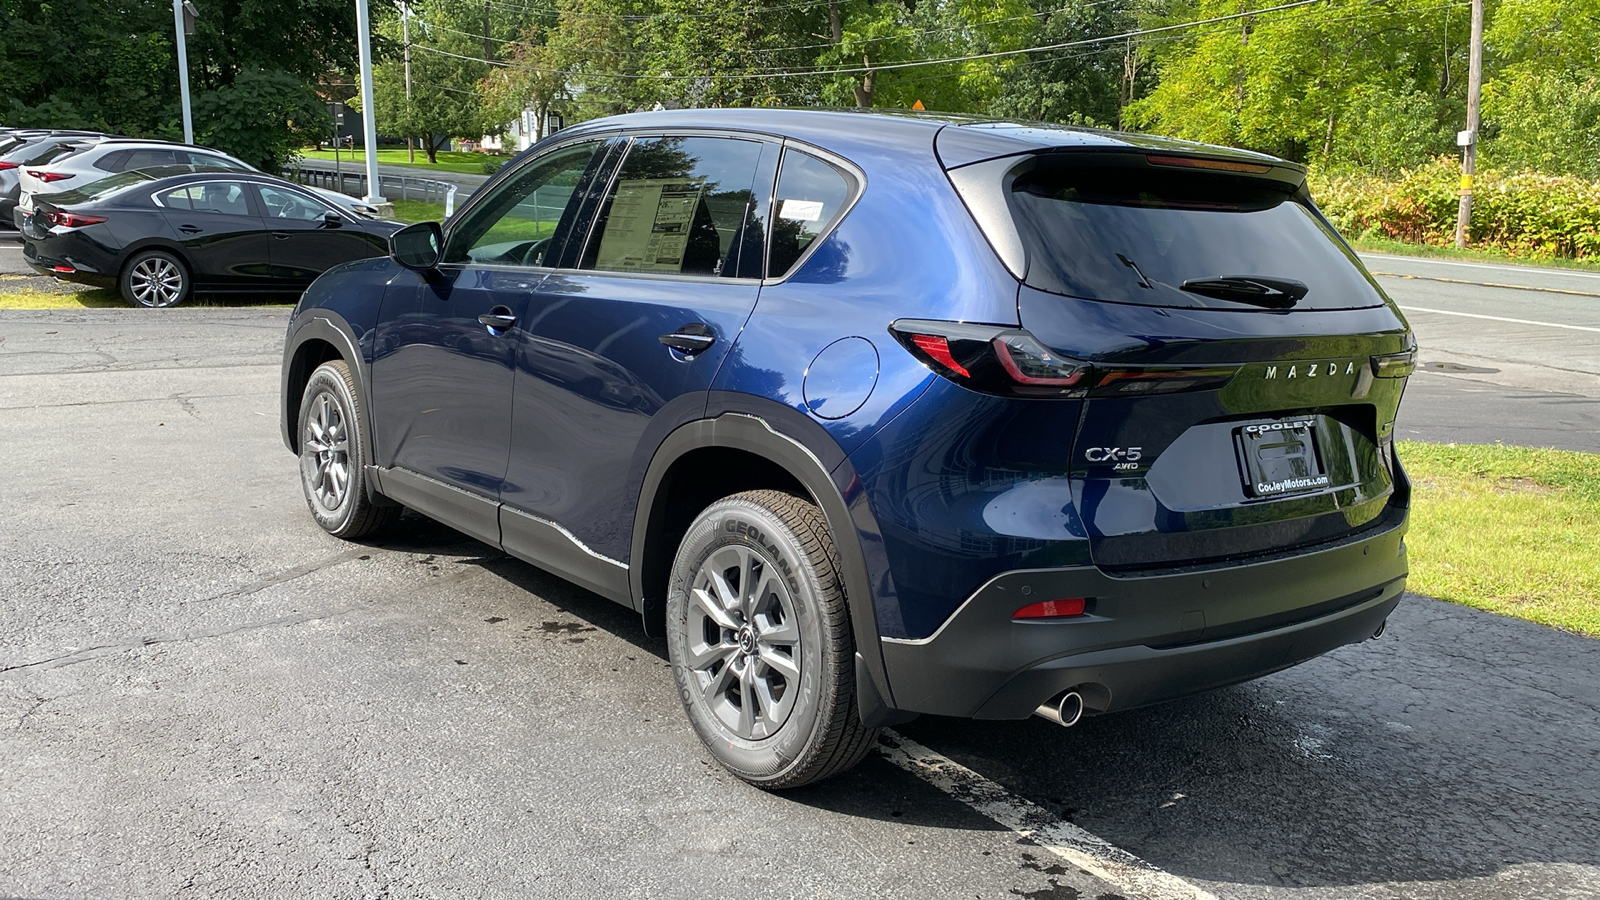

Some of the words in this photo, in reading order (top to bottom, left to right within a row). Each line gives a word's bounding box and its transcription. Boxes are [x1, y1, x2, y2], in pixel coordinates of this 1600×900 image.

[1265, 361, 1354, 379] MAZDA
[1246, 420, 1314, 432] COOLEY
[1084, 446, 1142, 462] CX-5
[1112, 462, 1139, 471] AWD
[1257, 475, 1328, 493] CooleyMotors.com
[724, 519, 812, 632] GEOLANDA
